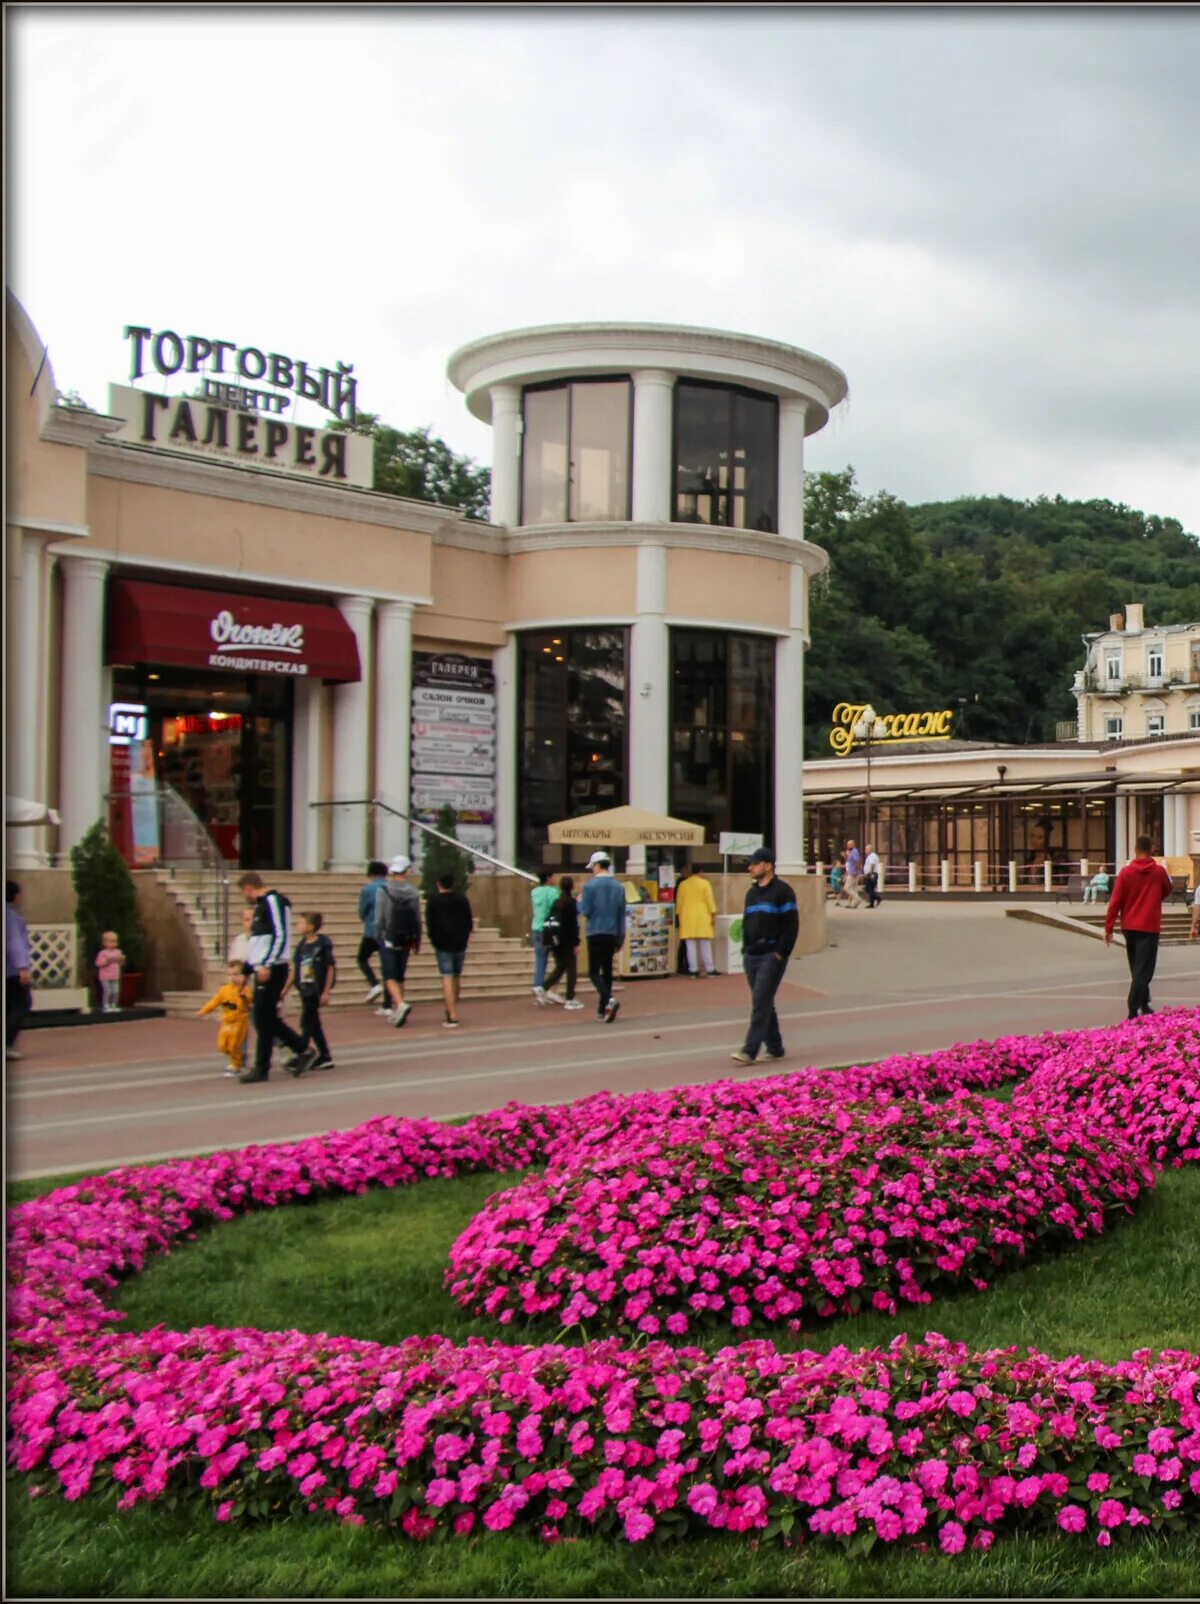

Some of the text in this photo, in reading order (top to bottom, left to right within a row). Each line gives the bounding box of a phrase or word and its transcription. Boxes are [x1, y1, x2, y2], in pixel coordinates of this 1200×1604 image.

[125, 325, 358, 425] ТОРГОВЫЙ
[203, 378, 291, 414] ЦЕНТР
[141, 393, 348, 479] ГАЛЕРЕЯ
[209, 654, 308, 675] КОНДИТЕРСКАЯ
[431, 661, 478, 678] ГАЛЕРЕЯ
[561, 829, 611, 839] АВТОКАРЫ
[638, 831, 695, 841] ЭКСКУРСИИ
